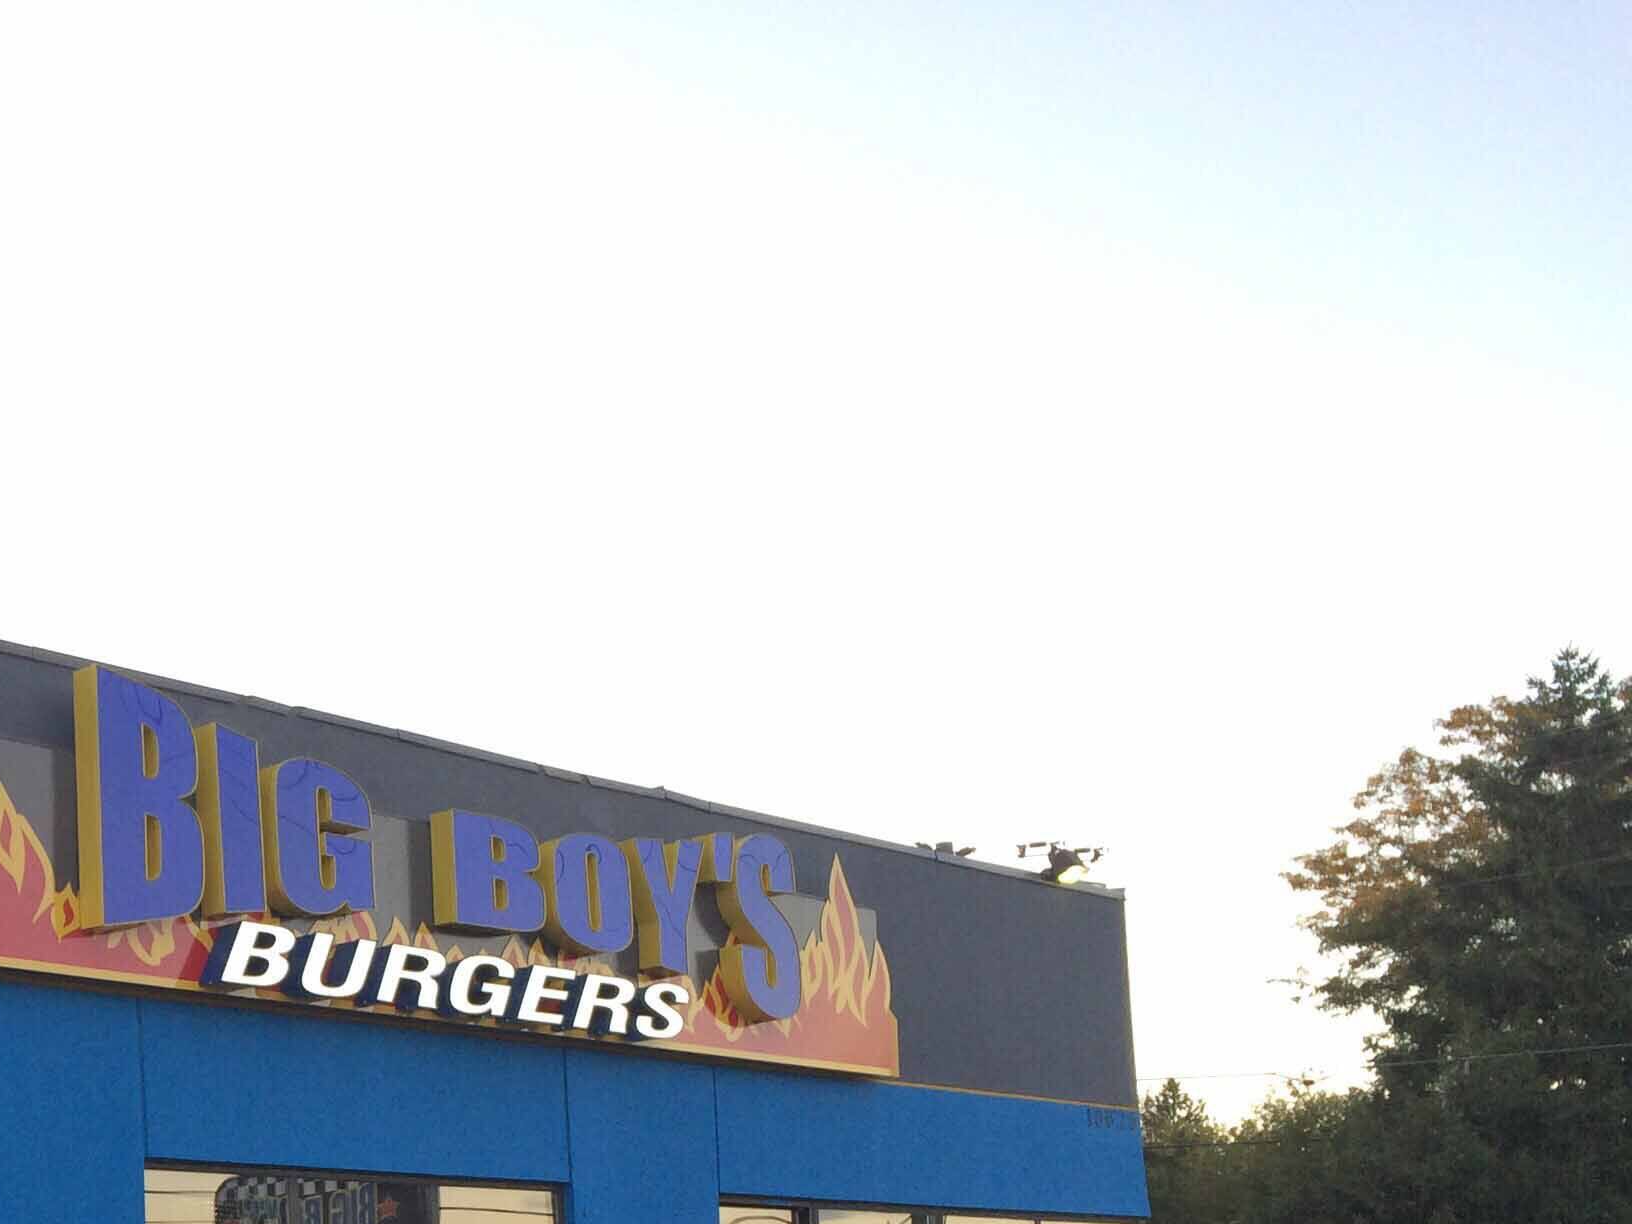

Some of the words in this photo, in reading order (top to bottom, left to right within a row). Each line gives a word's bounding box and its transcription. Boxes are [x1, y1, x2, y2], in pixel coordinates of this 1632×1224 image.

[74, 663, 377, 932] BIG
[430, 808, 802, 1022] BOY'S
[218, 919, 689, 1041] BURGERS
